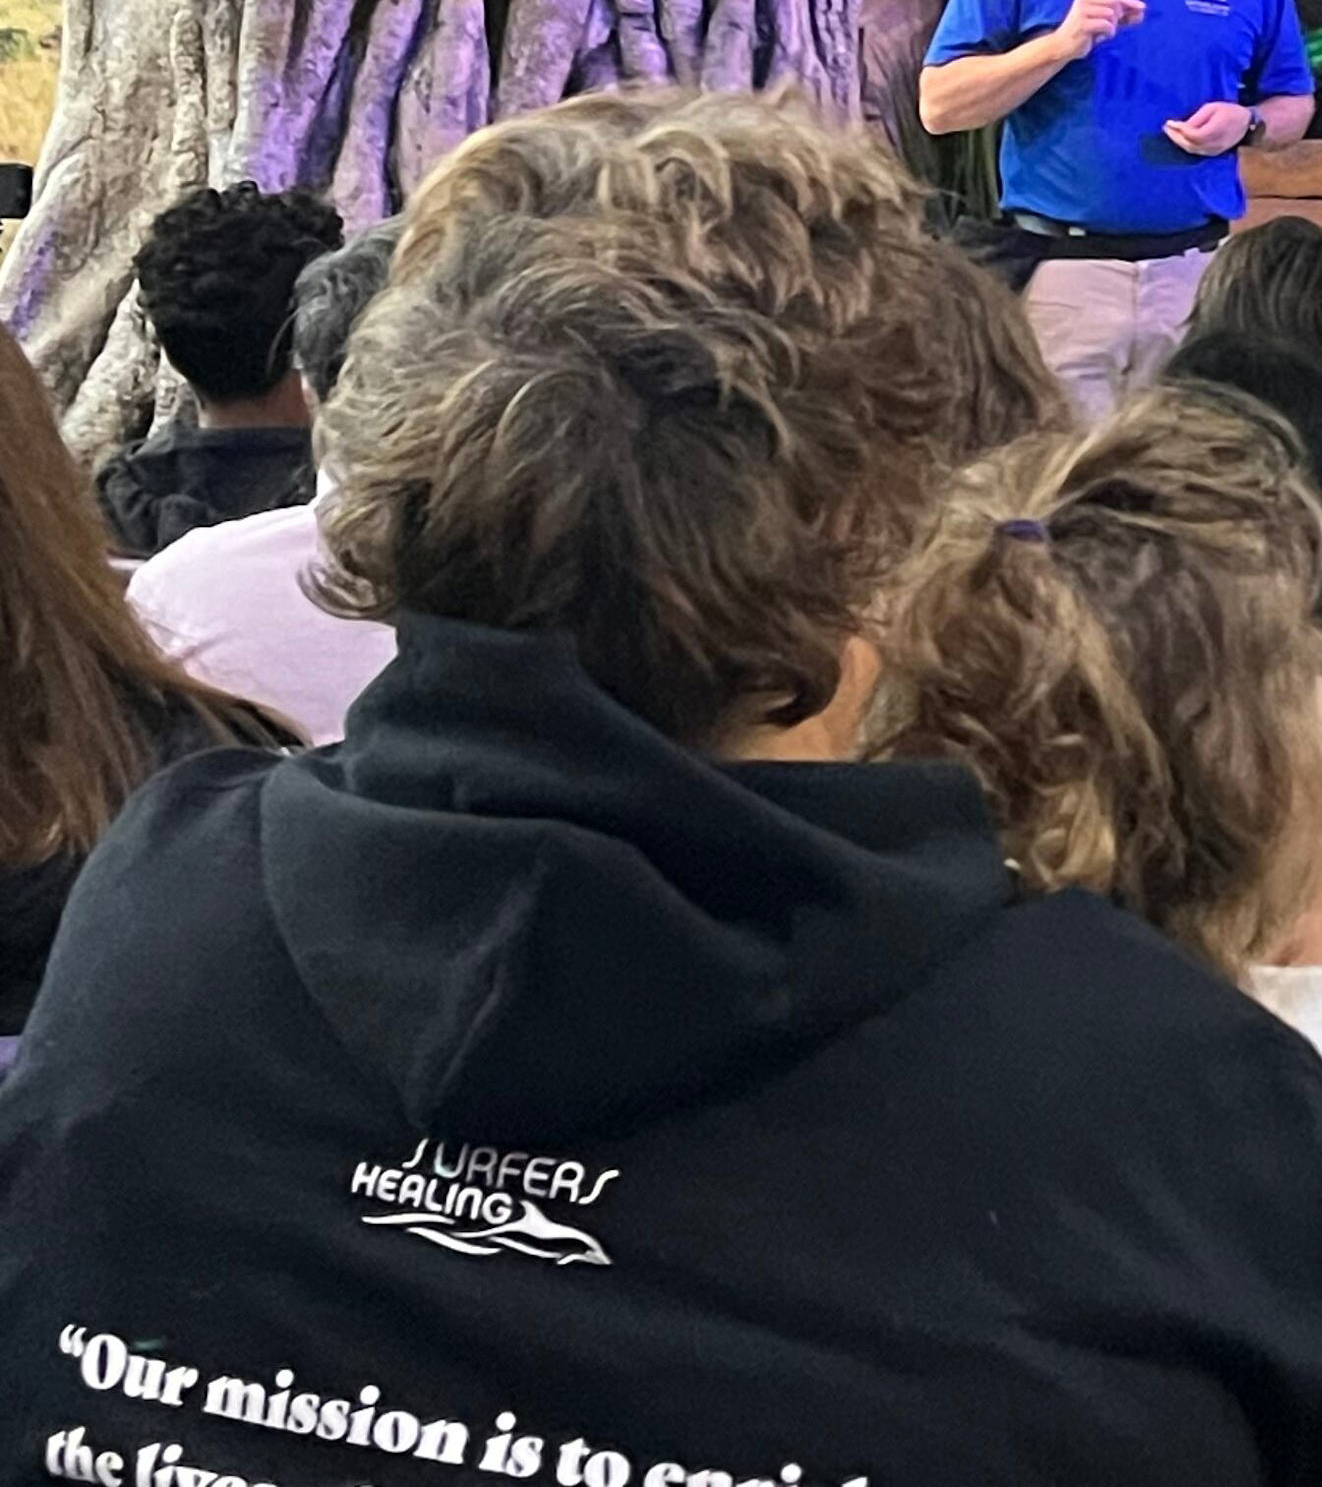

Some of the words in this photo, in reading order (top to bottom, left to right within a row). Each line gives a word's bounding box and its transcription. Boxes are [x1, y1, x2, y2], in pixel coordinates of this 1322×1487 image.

[351, 1162, 512, 1224] HEALING
[402, 1138, 619, 1204] SURFERS
[46, 1426, 124, 1487] the
[203, 1369, 469, 1465] mission
[479, 1411, 544, 1477] is
[556, 1437, 630, 1487] to
